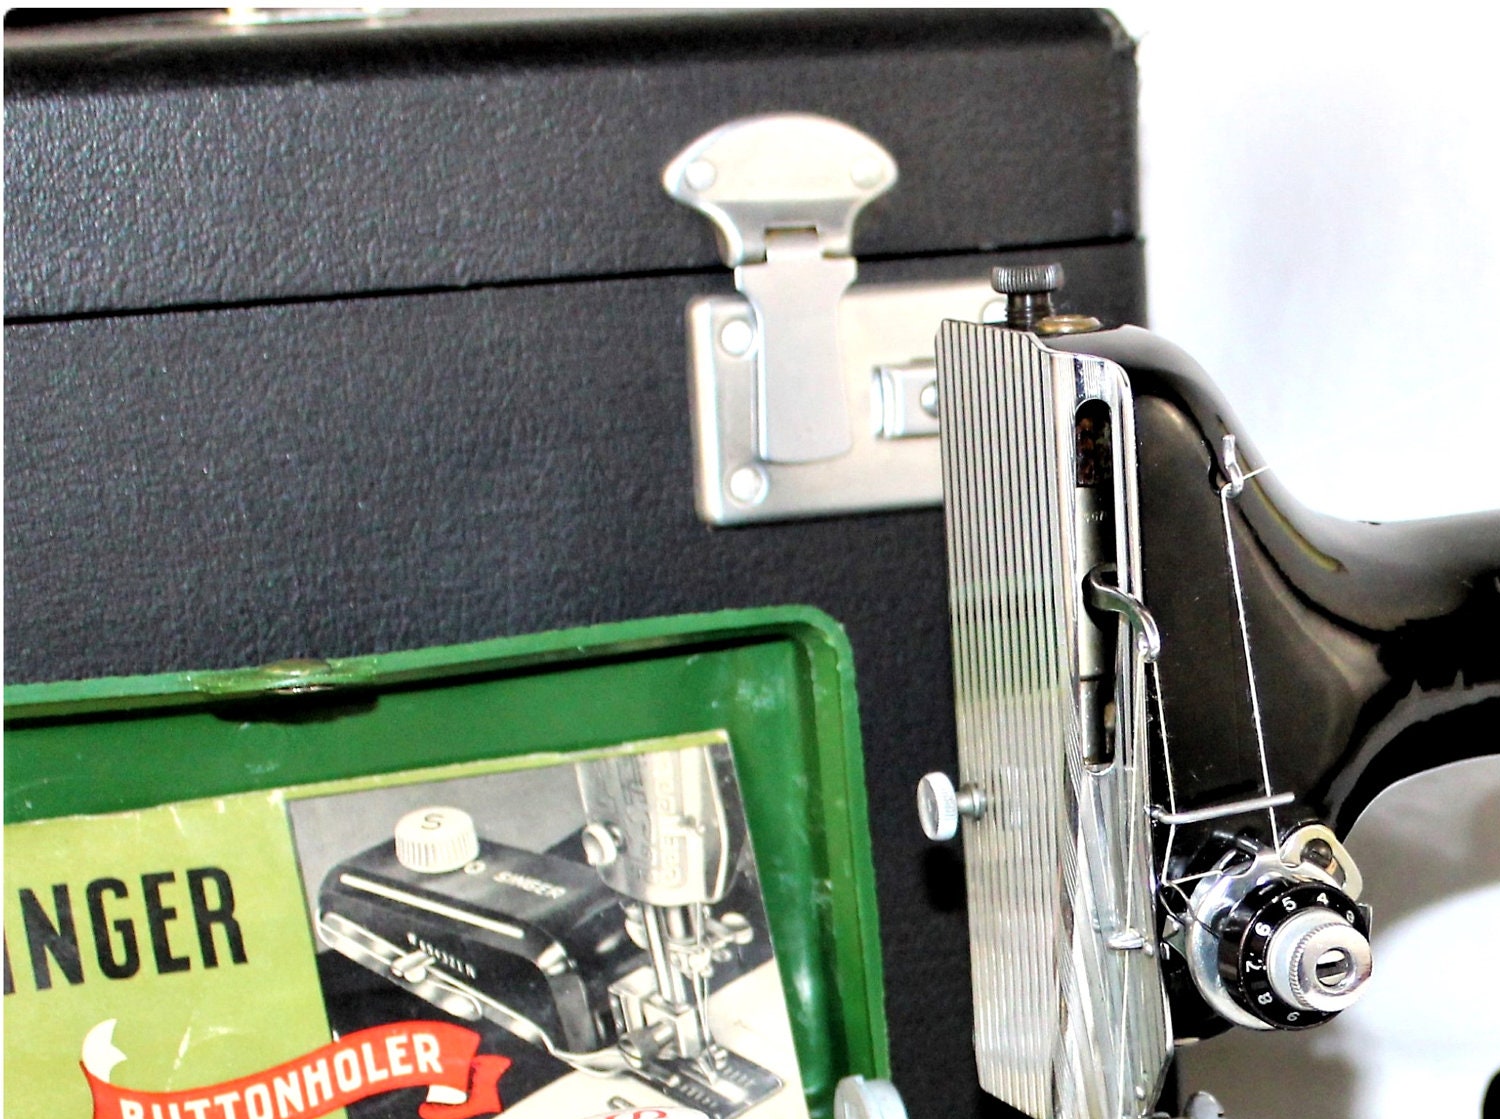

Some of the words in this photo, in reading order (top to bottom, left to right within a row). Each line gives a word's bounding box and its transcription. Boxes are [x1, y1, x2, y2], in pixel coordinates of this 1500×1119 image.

[421, 812, 445, 831] S
[1281, 895, 1298, 912] 5
[4, 866, 249, 996] NGER
